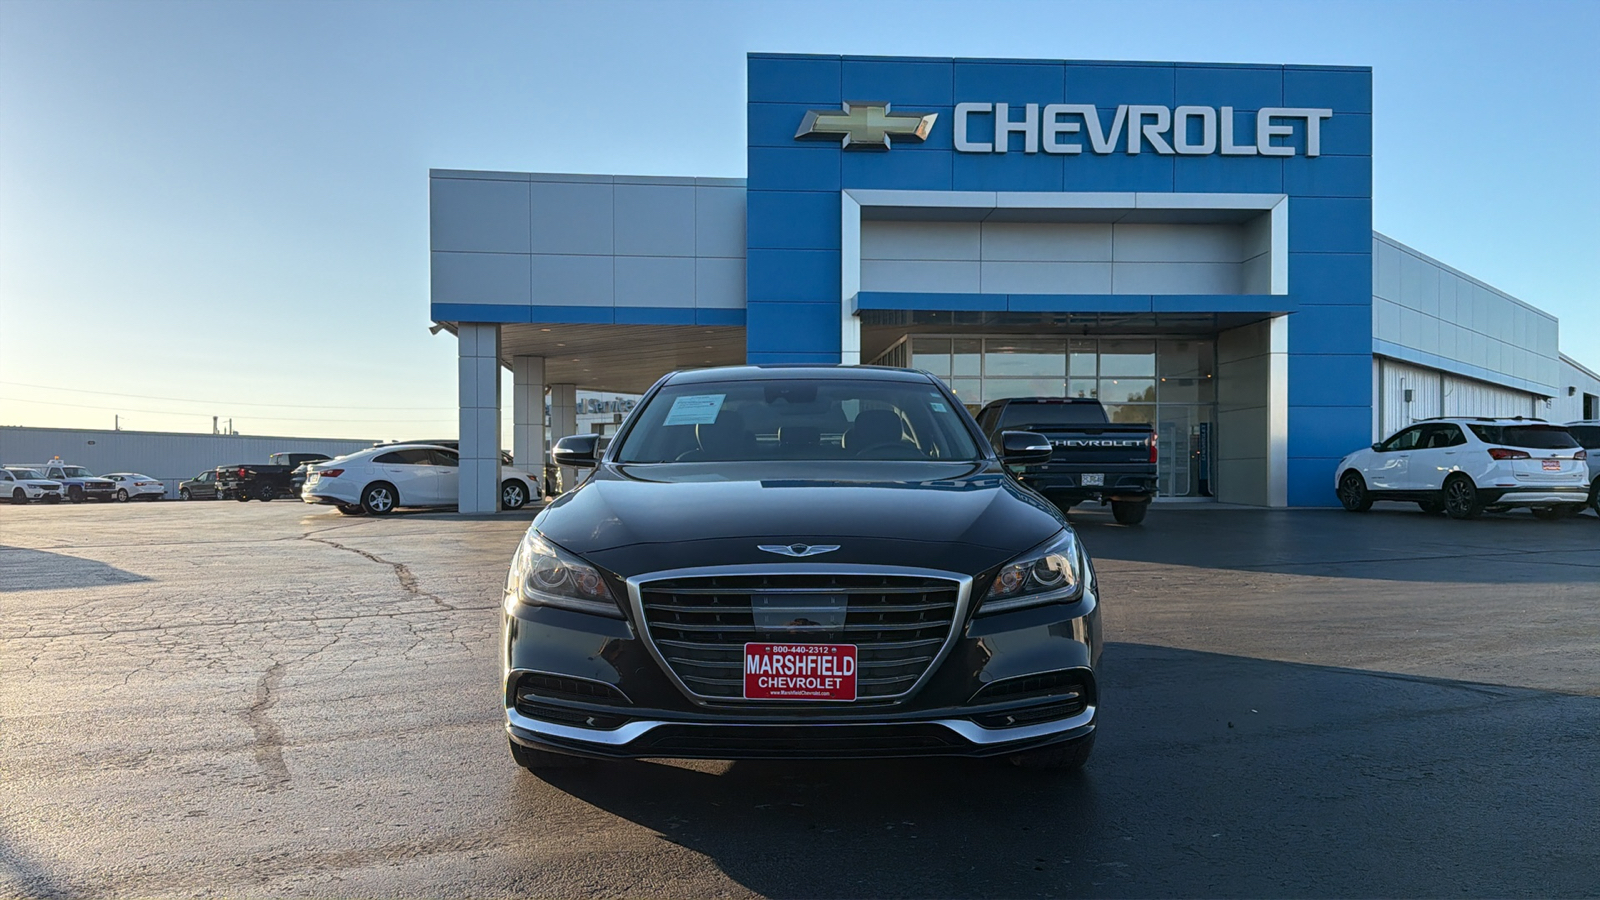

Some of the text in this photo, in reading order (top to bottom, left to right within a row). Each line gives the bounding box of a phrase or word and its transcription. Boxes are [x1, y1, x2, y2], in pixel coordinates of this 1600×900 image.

[953, 102, 1333, 157] CHEVROLET
[588, 397, 637, 414] Service
[747, 654, 854, 675] MARSHFIELD
[758, 677, 842, 689] CHEVROLET
